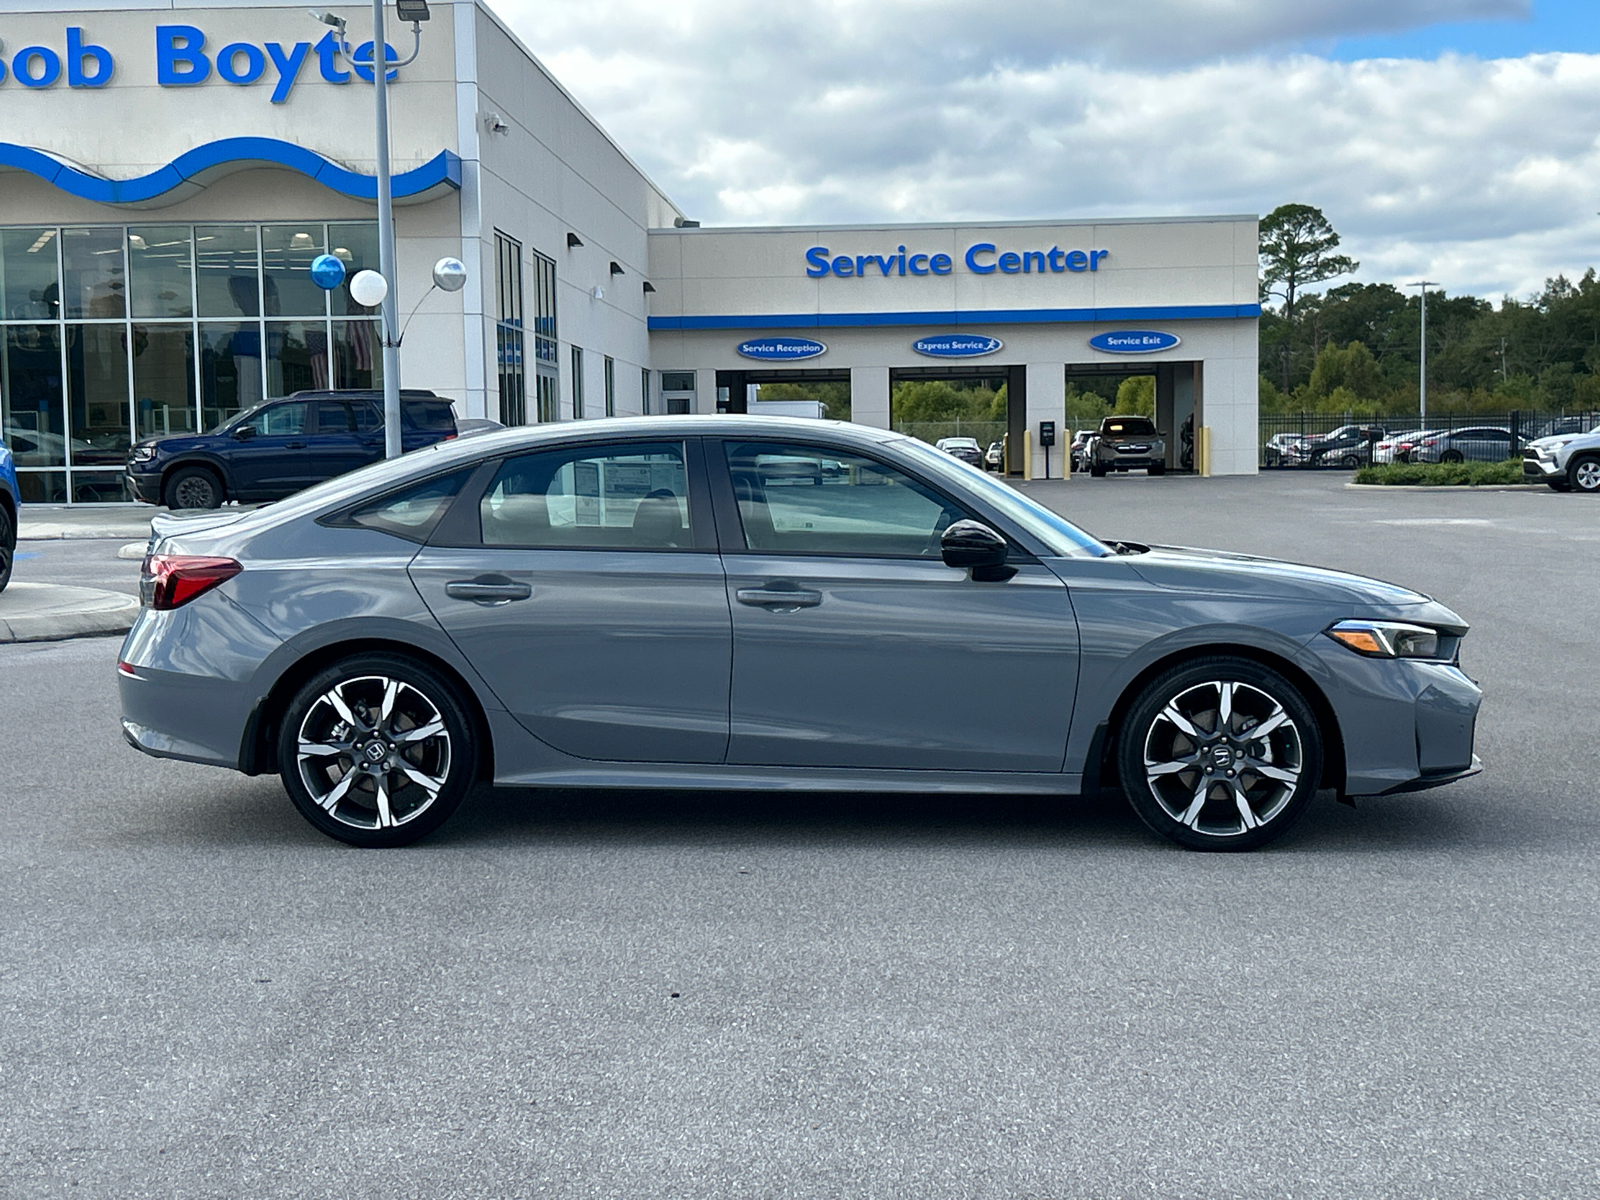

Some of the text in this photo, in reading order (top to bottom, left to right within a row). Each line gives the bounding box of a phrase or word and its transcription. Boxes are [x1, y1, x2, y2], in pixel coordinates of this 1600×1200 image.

[0, 25, 398, 104] ob Boyte
[805, 243, 1108, 278] Service Center
[917, 341, 984, 351] Express Service
[1107, 336, 1161, 346] Service Exit
[742, 344, 820, 354] Service Reception
